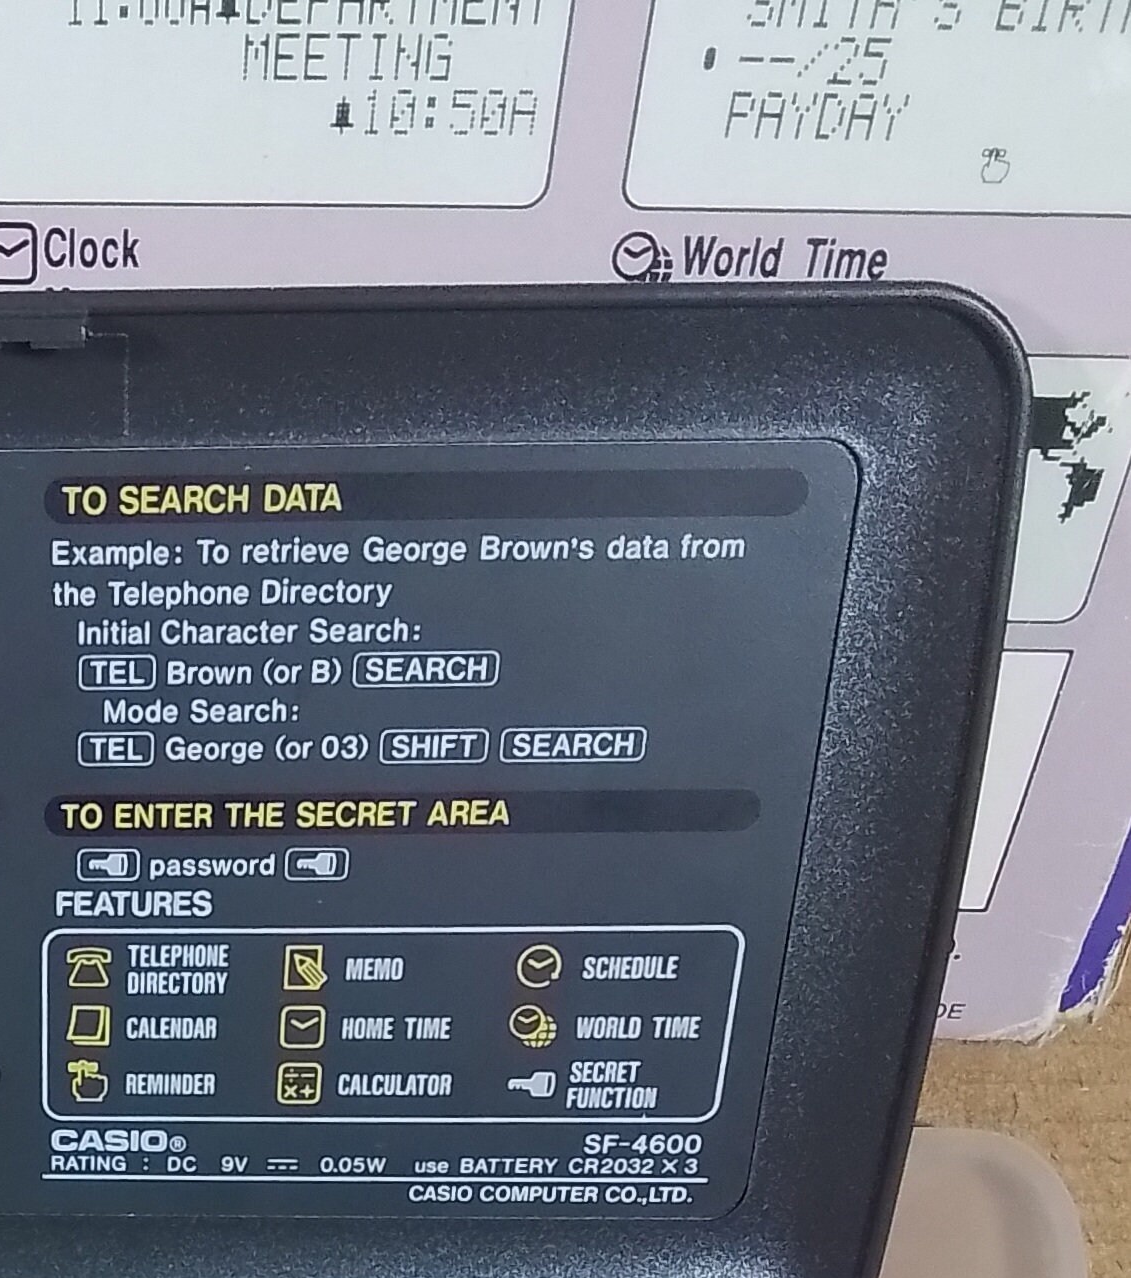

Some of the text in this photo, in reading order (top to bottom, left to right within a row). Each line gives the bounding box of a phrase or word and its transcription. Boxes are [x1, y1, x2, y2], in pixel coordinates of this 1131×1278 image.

[241, 32, 453, 81] MEETING
[364, 88, 538, 135] 10:50A
[724, 90, 910, 140] PAYDAY
[44, 228, 139, 268] Clock
[685, 236, 890, 279] World Time
[62, 484, 341, 515] TO SEARCH DATA
[79, 618, 420, 644] Initial Character Search:
[104, 698, 298, 723] Mode Search:
[150, 854, 275, 880] password
[56, 890, 212, 917] FEATURES
[128, 945, 229, 967] TELEPHONE
[346, 958, 403, 980] MEMO
[583, 956, 679, 979] SCHEDULE
[128, 972, 227, 994] DIRECTORY
[127, 1017, 216, 1039] CALENDAR
[342, 1018, 451, 1039] HOME TIME
[577, 1017, 701, 1038] WORLD TIME
[570, 1062, 641, 1083] SECRET
[126, 1074, 215, 1094] REMINDER
[338, 1074, 452, 1095] CALCULATOR
[567, 1087, 657, 1108] FUNCTION
[584, 1134, 701, 1154] SF-4600
[52, 1156, 697, 1174] RATING DC 9V 0.05W use BATTERY CR2032 3
[409, 1185, 472, 1201] CASIO
[480, 1186, 598, 1202] COMPUTER
